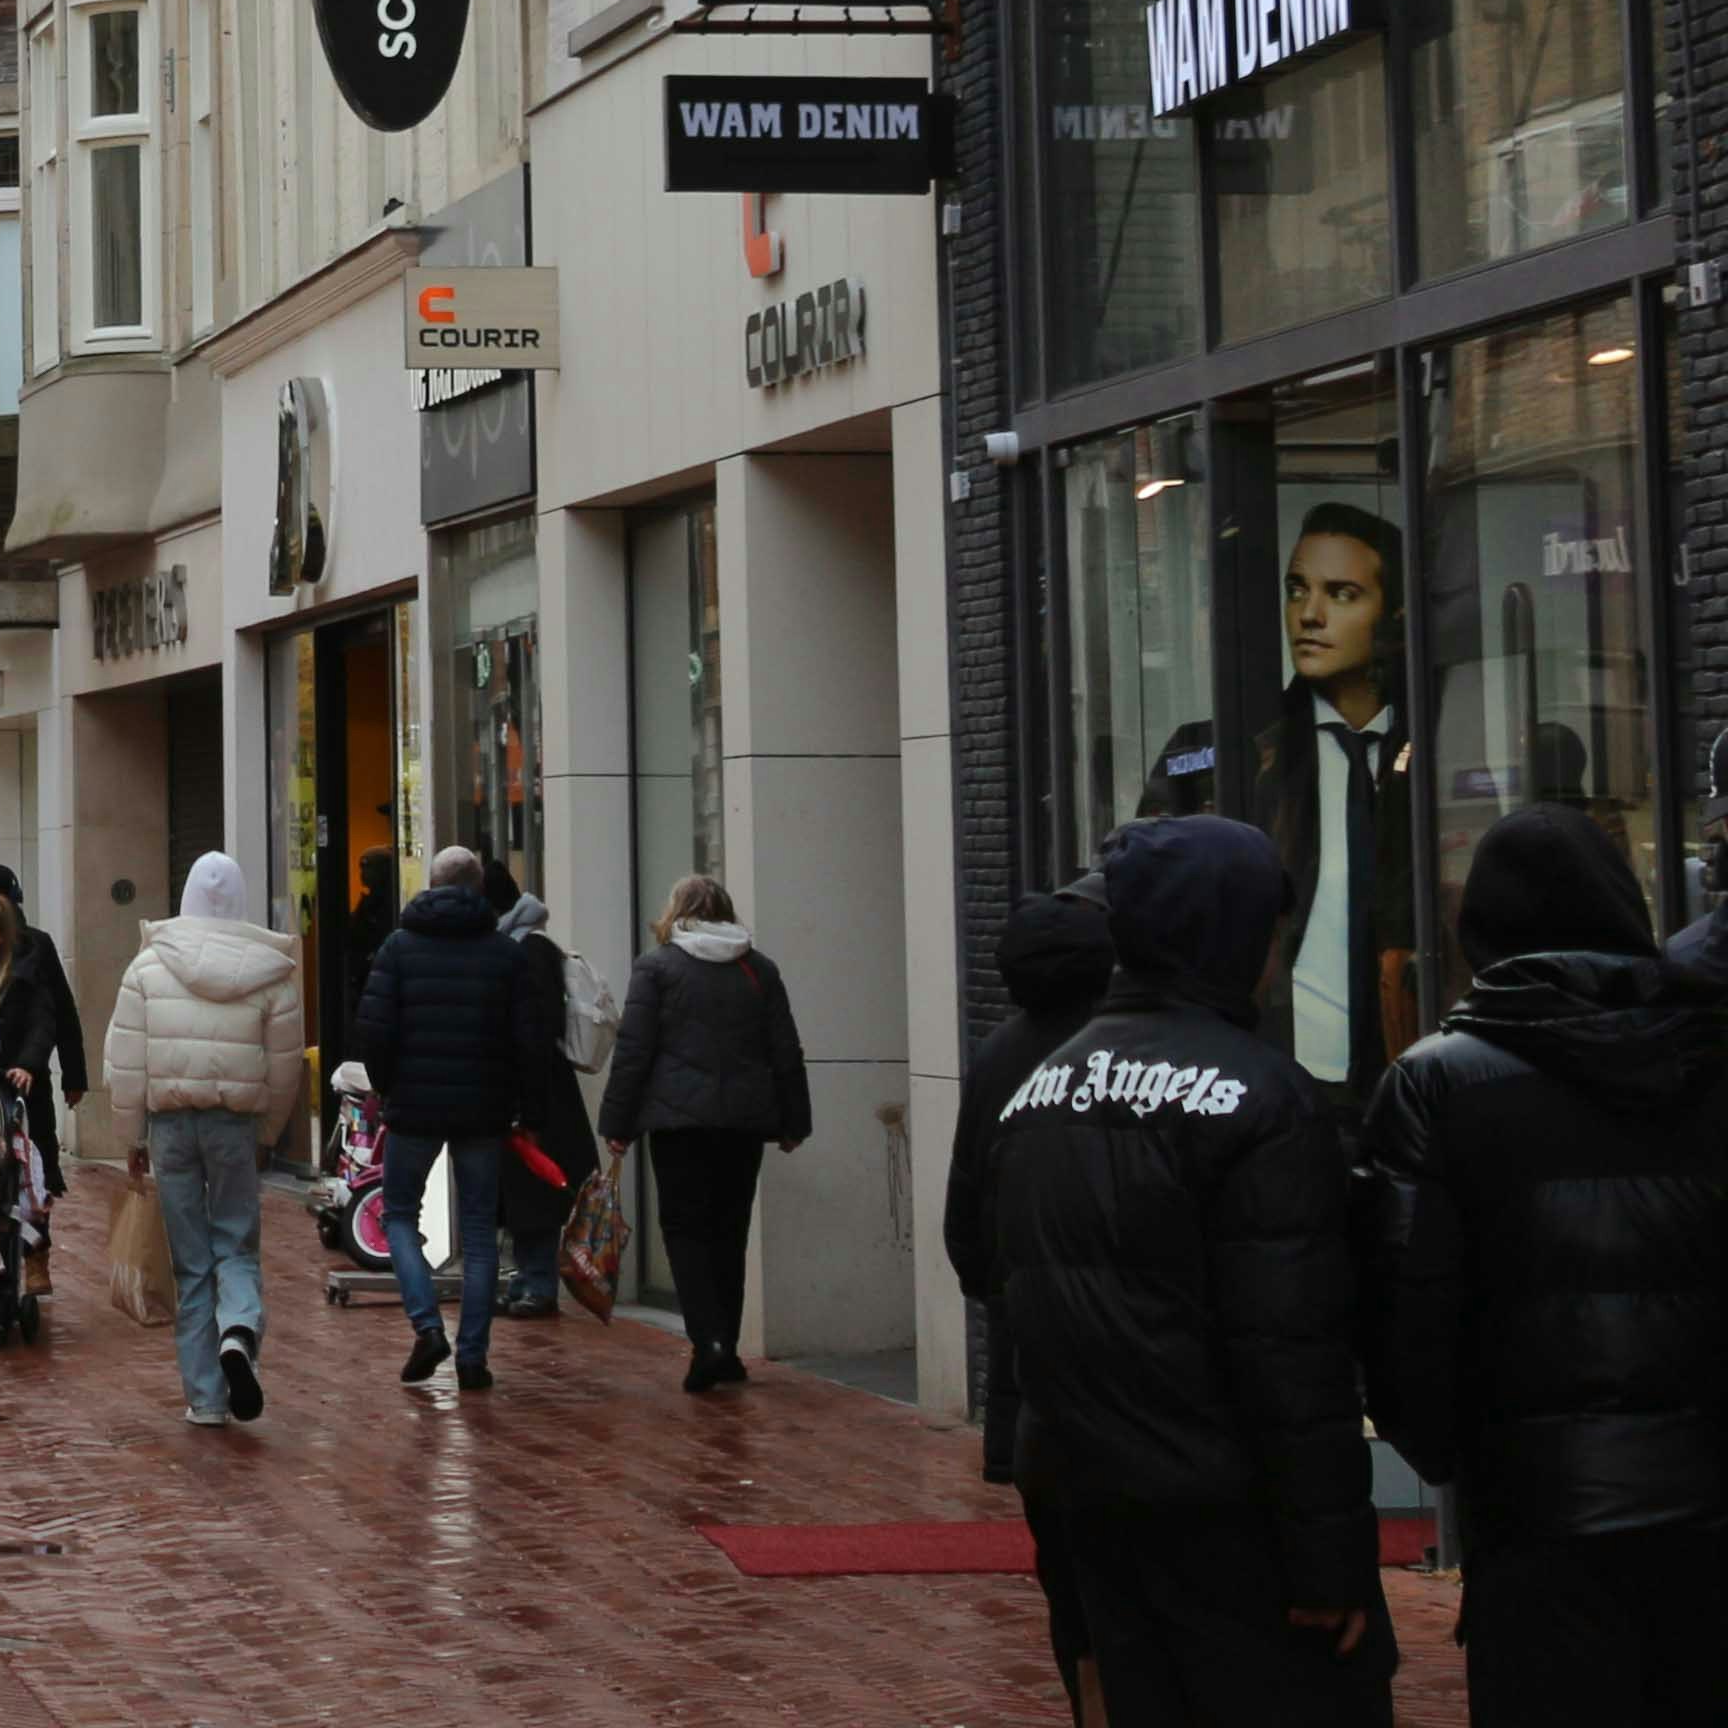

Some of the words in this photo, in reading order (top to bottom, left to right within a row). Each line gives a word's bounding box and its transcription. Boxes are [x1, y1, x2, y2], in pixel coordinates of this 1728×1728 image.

[680, 103, 782, 140] WAM
[799, 103, 920, 141] DENIM
[419, 328, 540, 348] COURIR
[746, 278, 860, 388] COURIR
[1072, 1049, 1247, 1119] Angels
